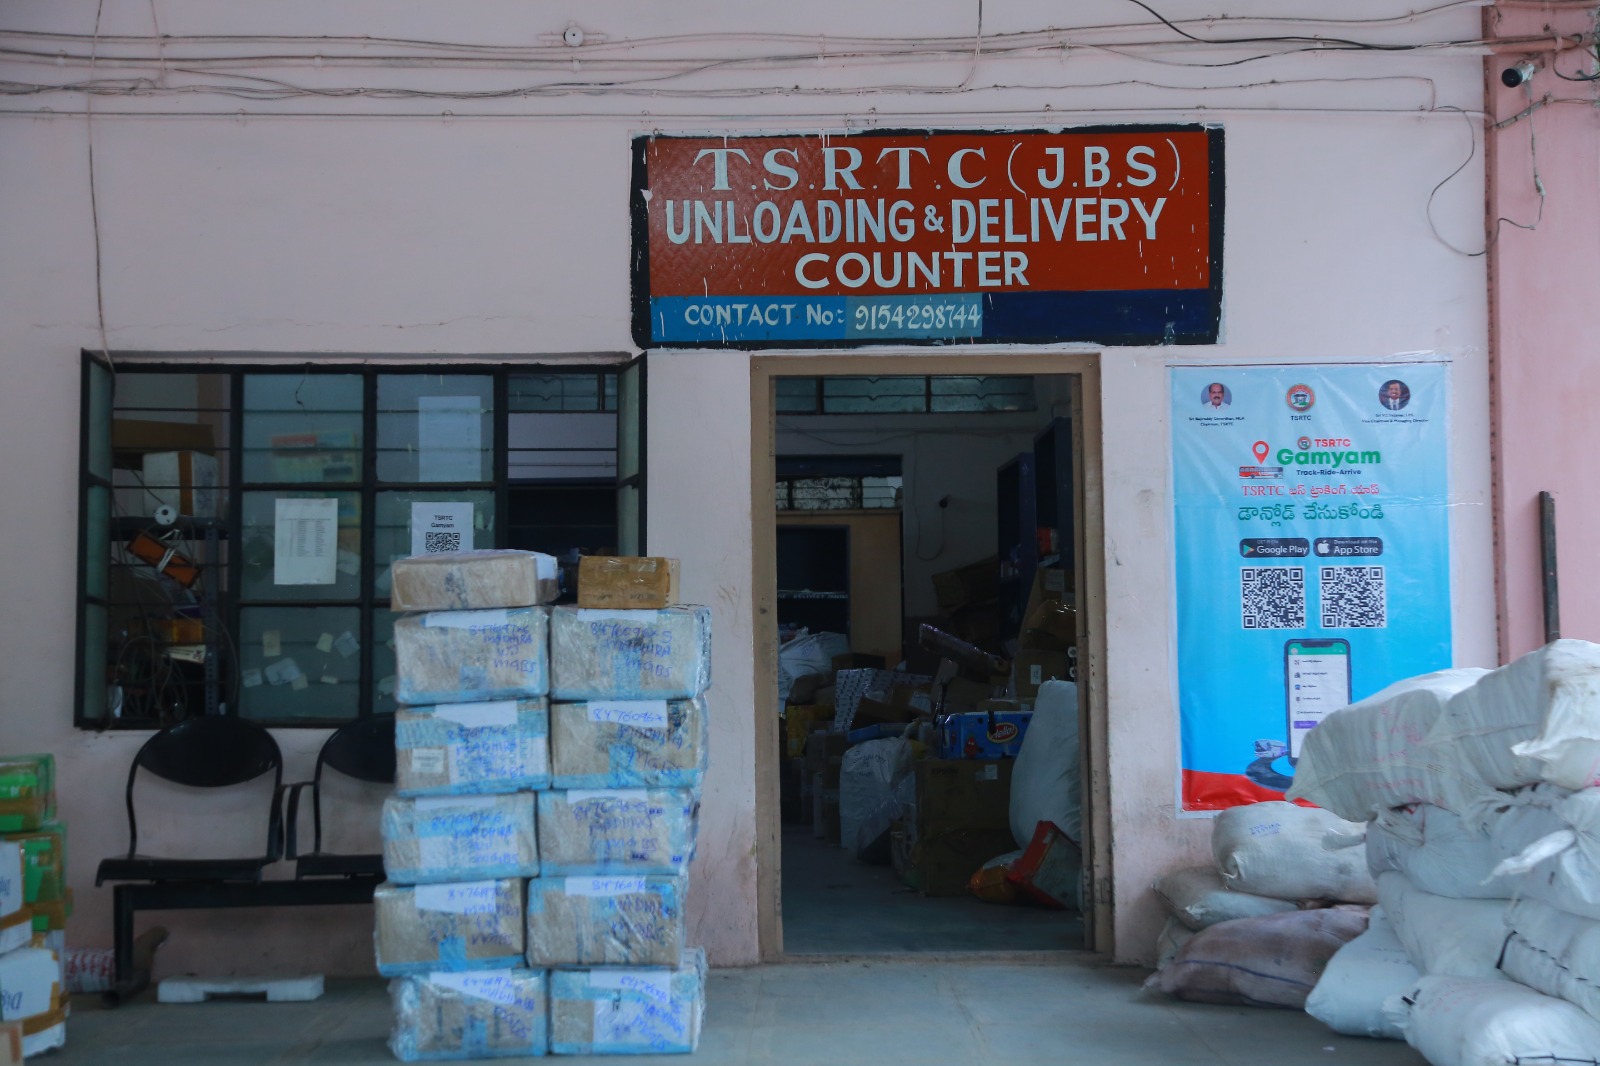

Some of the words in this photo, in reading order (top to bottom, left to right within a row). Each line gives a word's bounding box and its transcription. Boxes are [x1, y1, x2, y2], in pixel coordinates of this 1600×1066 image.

[666, 198, 915, 244] UNLOADING
[923, 205, 944, 232] &
[952, 197, 1167, 244] DELIVERY
[795, 251, 1030, 289] COUNTER
[684, 303, 793, 326] CONTACT
[806, 303, 845, 326] No:
[854, 303, 981, 331] 9154298744
[1314, 439, 1351, 447] TSRTC
[1276, 449, 1381, 468] Gamyam
[1241, 485, 1285, 496] TSRTC
[1257, 546, 1288, 555] Google
[1289, 545, 1308, 554] Play
[1334, 546, 1353, 555] App
[1354, 546, 1379, 554] Store
